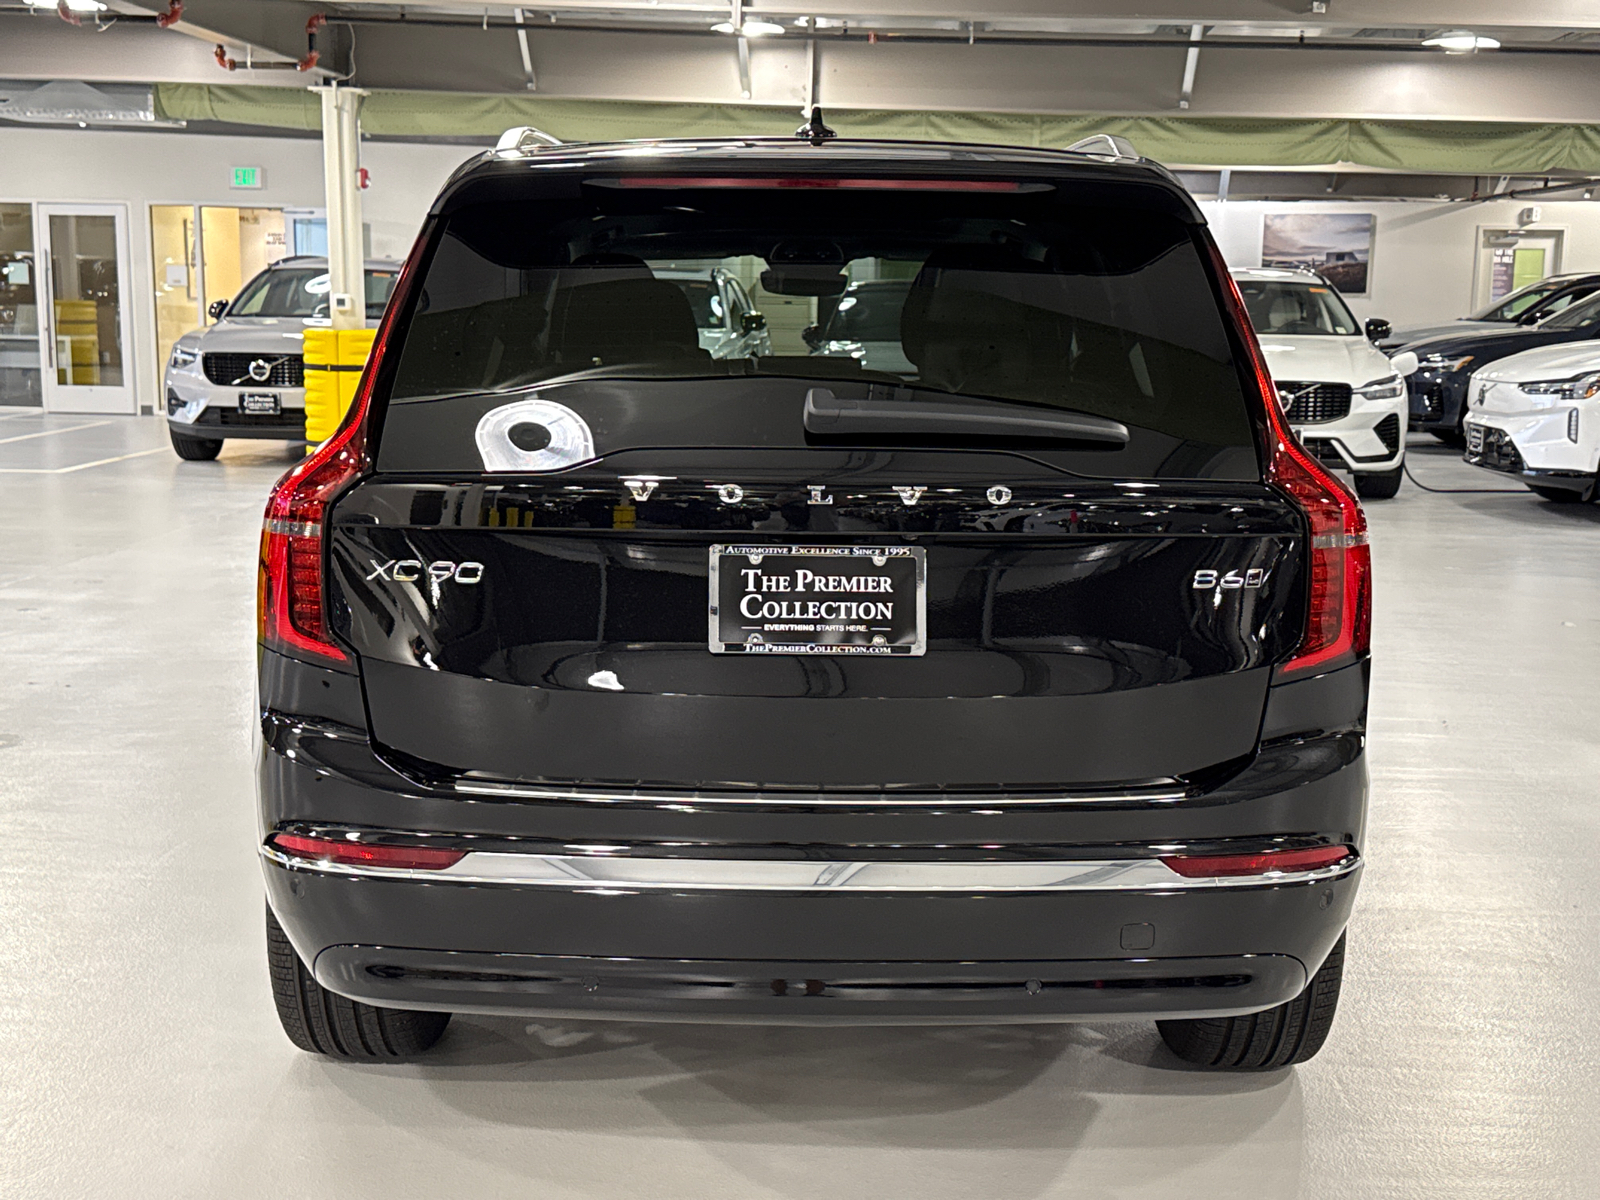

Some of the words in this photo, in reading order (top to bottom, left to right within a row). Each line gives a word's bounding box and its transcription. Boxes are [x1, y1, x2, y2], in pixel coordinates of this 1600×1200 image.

[235, 168, 256, 185] EXIT
[623, 480, 1013, 506] VOLVO
[725, 545, 789, 555] AUTOMOTIVE
[791, 546, 851, 555] EXCELLENCE
[852, 546, 882, 556] SINCE
[884, 547, 911, 556] 1995
[366, 559, 485, 584] XC90
[741, 569, 791, 592] THE
[795, 569, 894, 593] PREMIER
[739, 594, 894, 620] COLLECTION
[763, 623, 815, 632] EVERYTHING
[816, 624, 845, 632] STARTS
